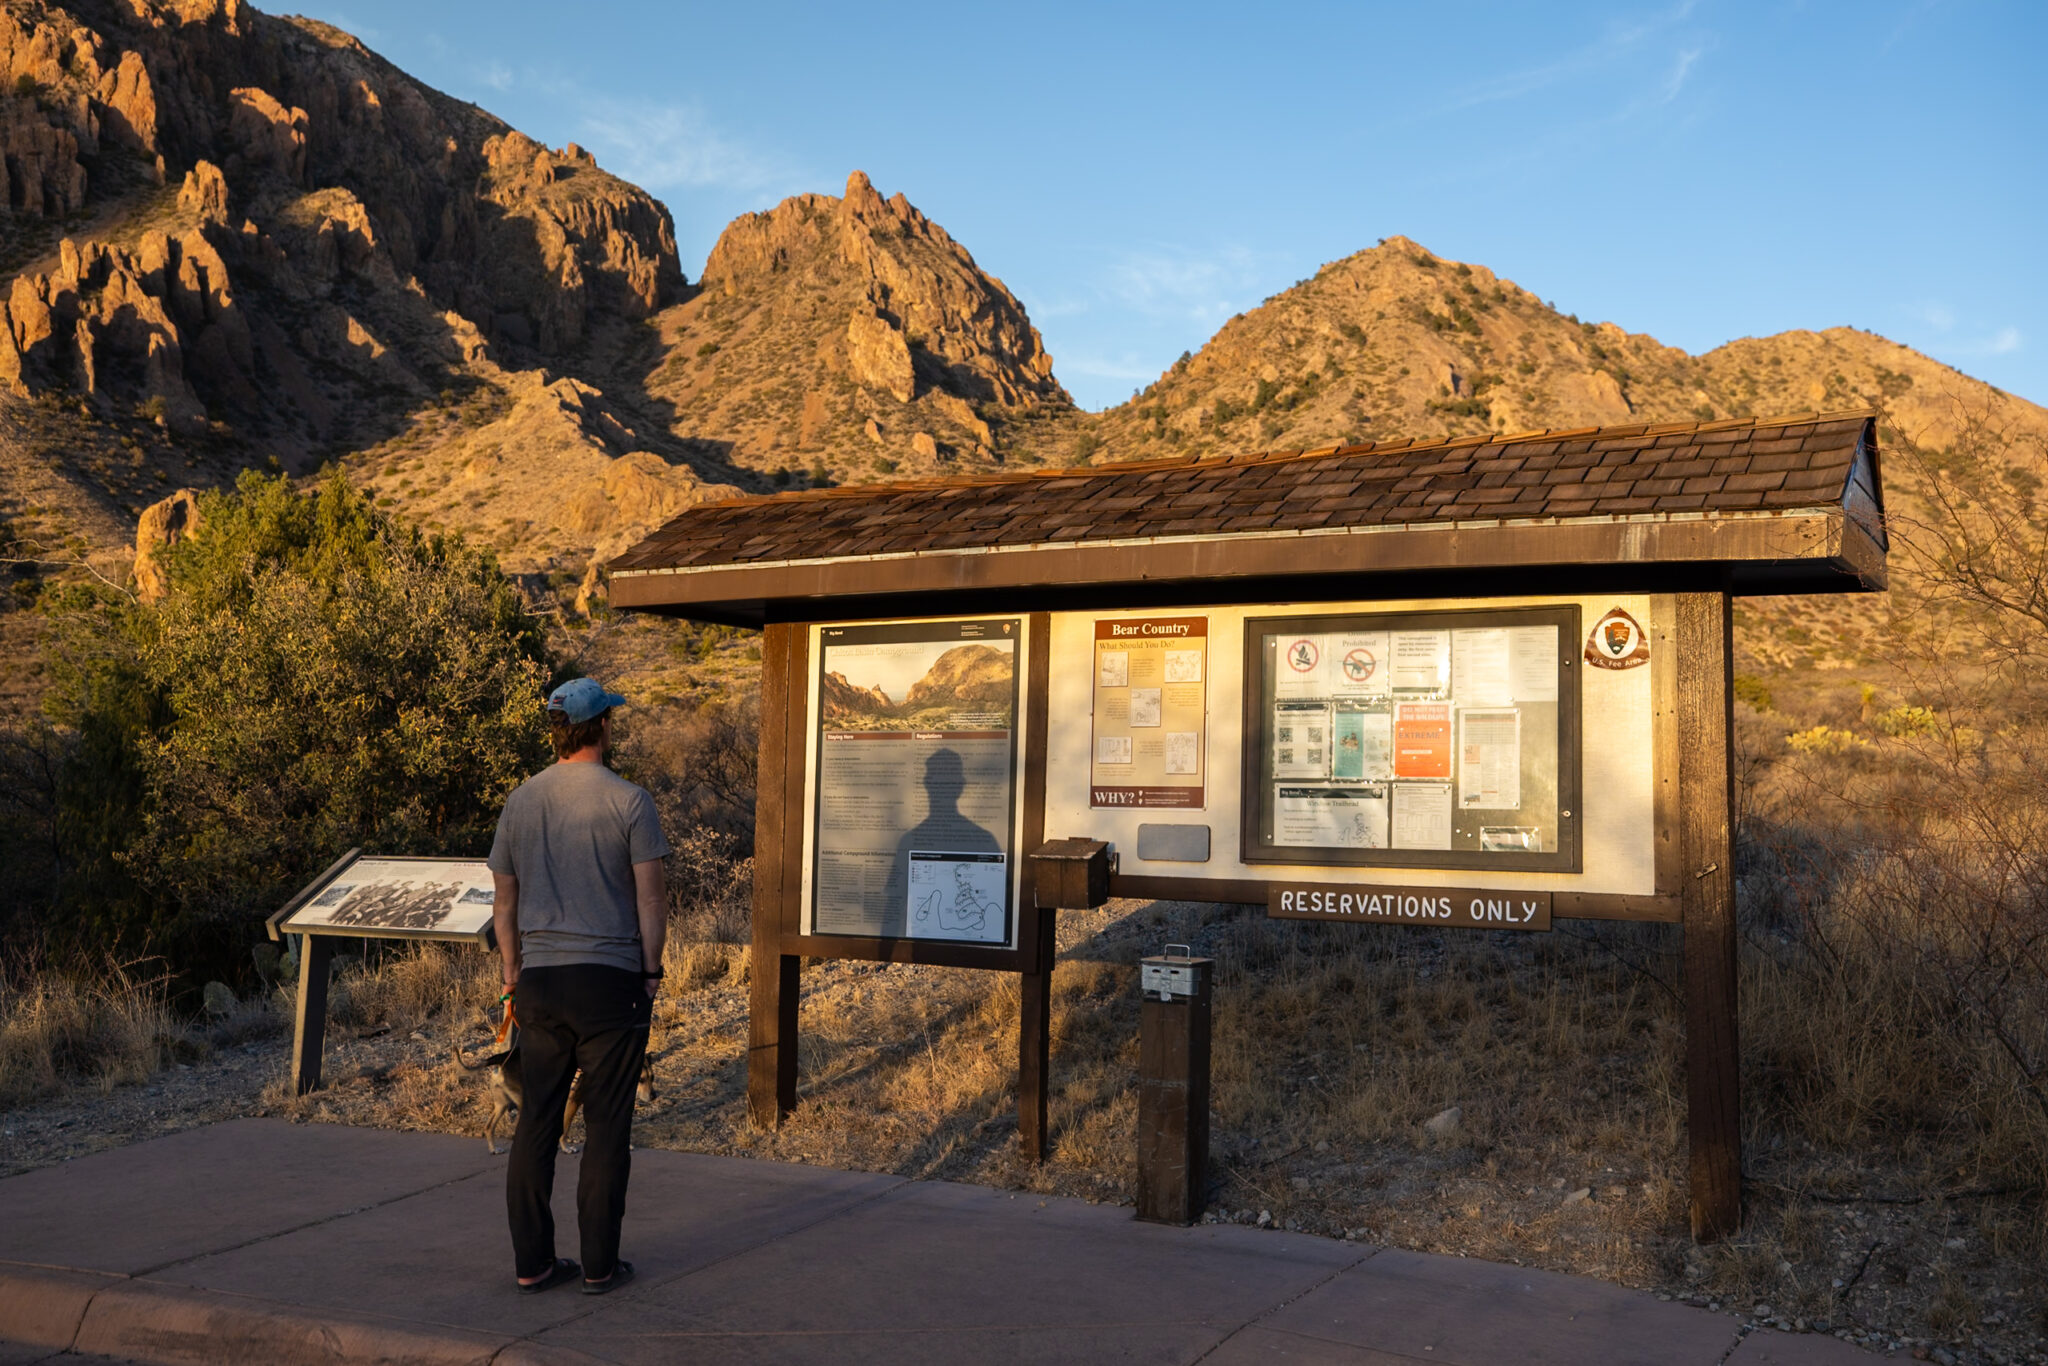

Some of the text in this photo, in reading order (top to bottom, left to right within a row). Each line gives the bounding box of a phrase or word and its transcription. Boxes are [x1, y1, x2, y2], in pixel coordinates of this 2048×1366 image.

[1112, 623, 1190, 636] Bear Country
[1099, 640, 1176, 650] What Should You Do?
[1342, 640, 1377, 648] Prohibited
[1591, 657, 1642, 668] U.S. Fee Area
[1398, 731, 1440, 740] EXTREME
[1094, 791, 1135, 804] WHY?
[1280, 890, 1537, 923] RESERVATIONS ONLY
